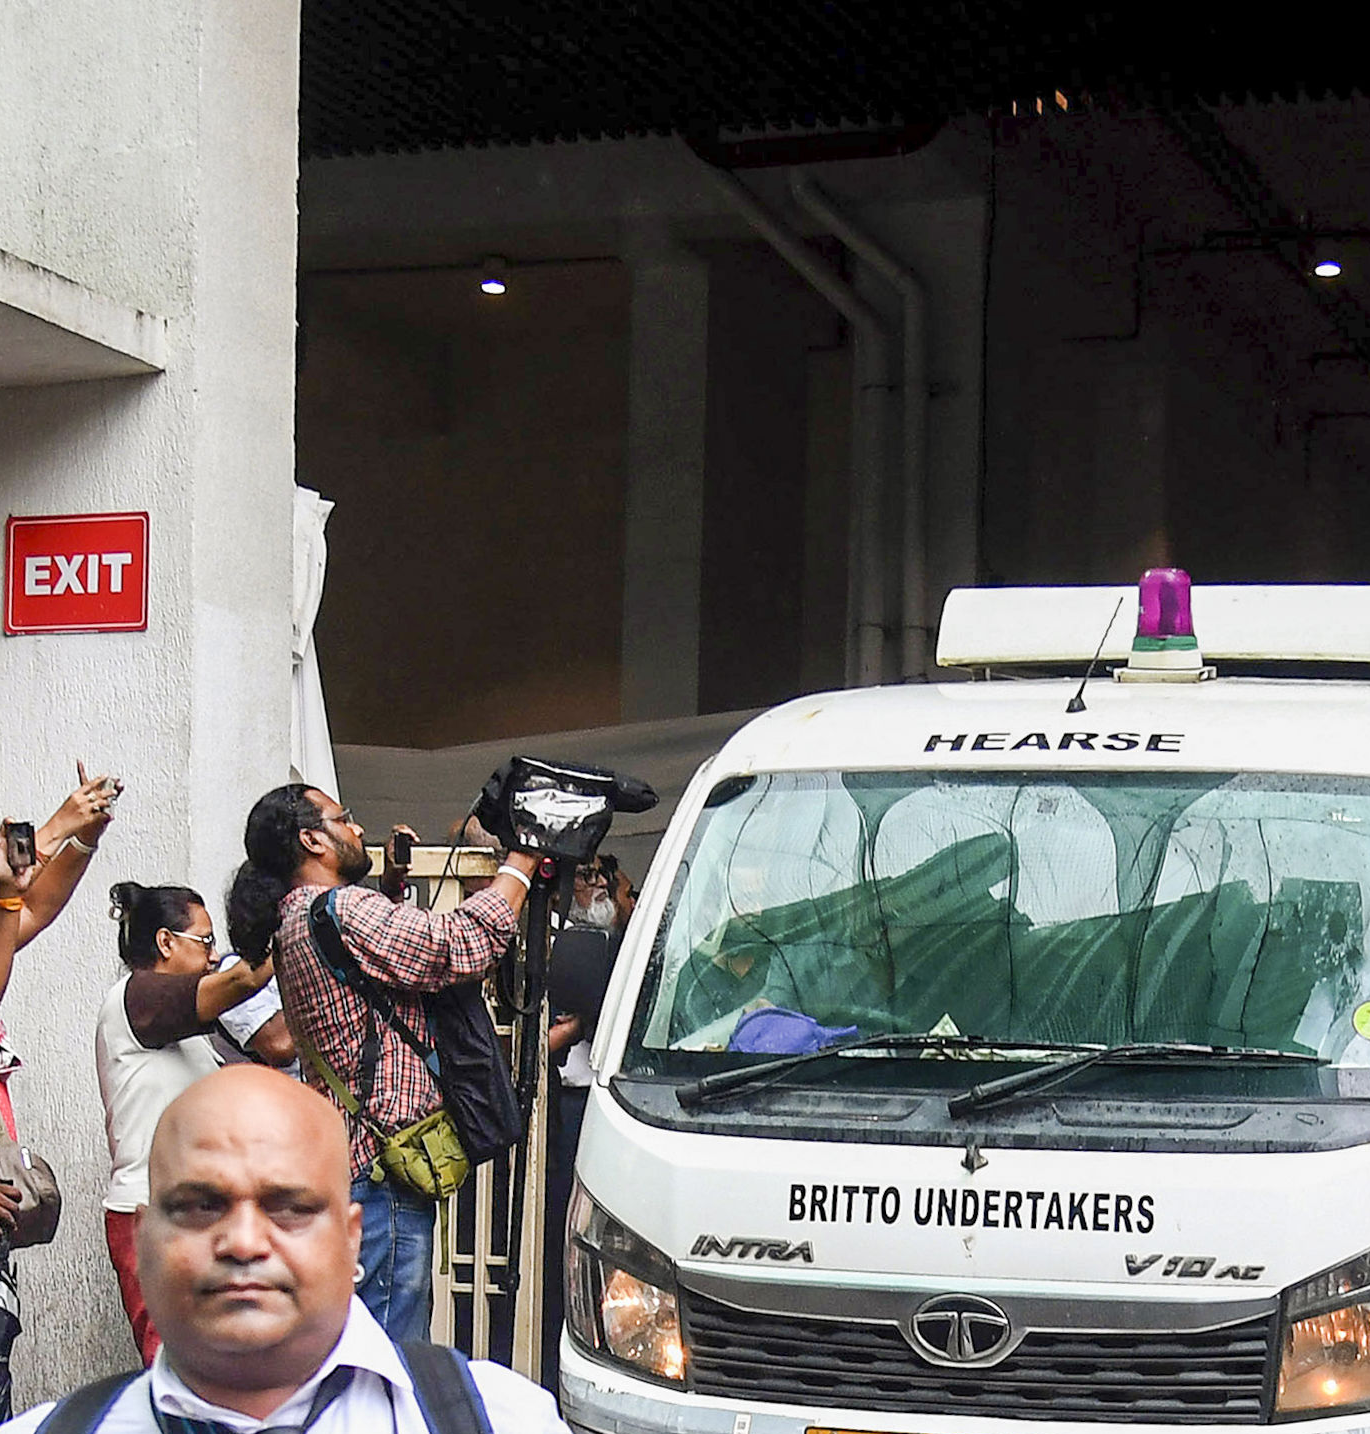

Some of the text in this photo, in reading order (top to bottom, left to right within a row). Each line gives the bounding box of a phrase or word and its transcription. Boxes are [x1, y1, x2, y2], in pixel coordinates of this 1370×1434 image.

[24, 552, 132, 596] EXIT
[923, 732, 1185, 752] HEARSE
[789, 1184, 1155, 1234] BRITTO UNDERTAKERS
[690, 1235, 814, 1263] INTRA
